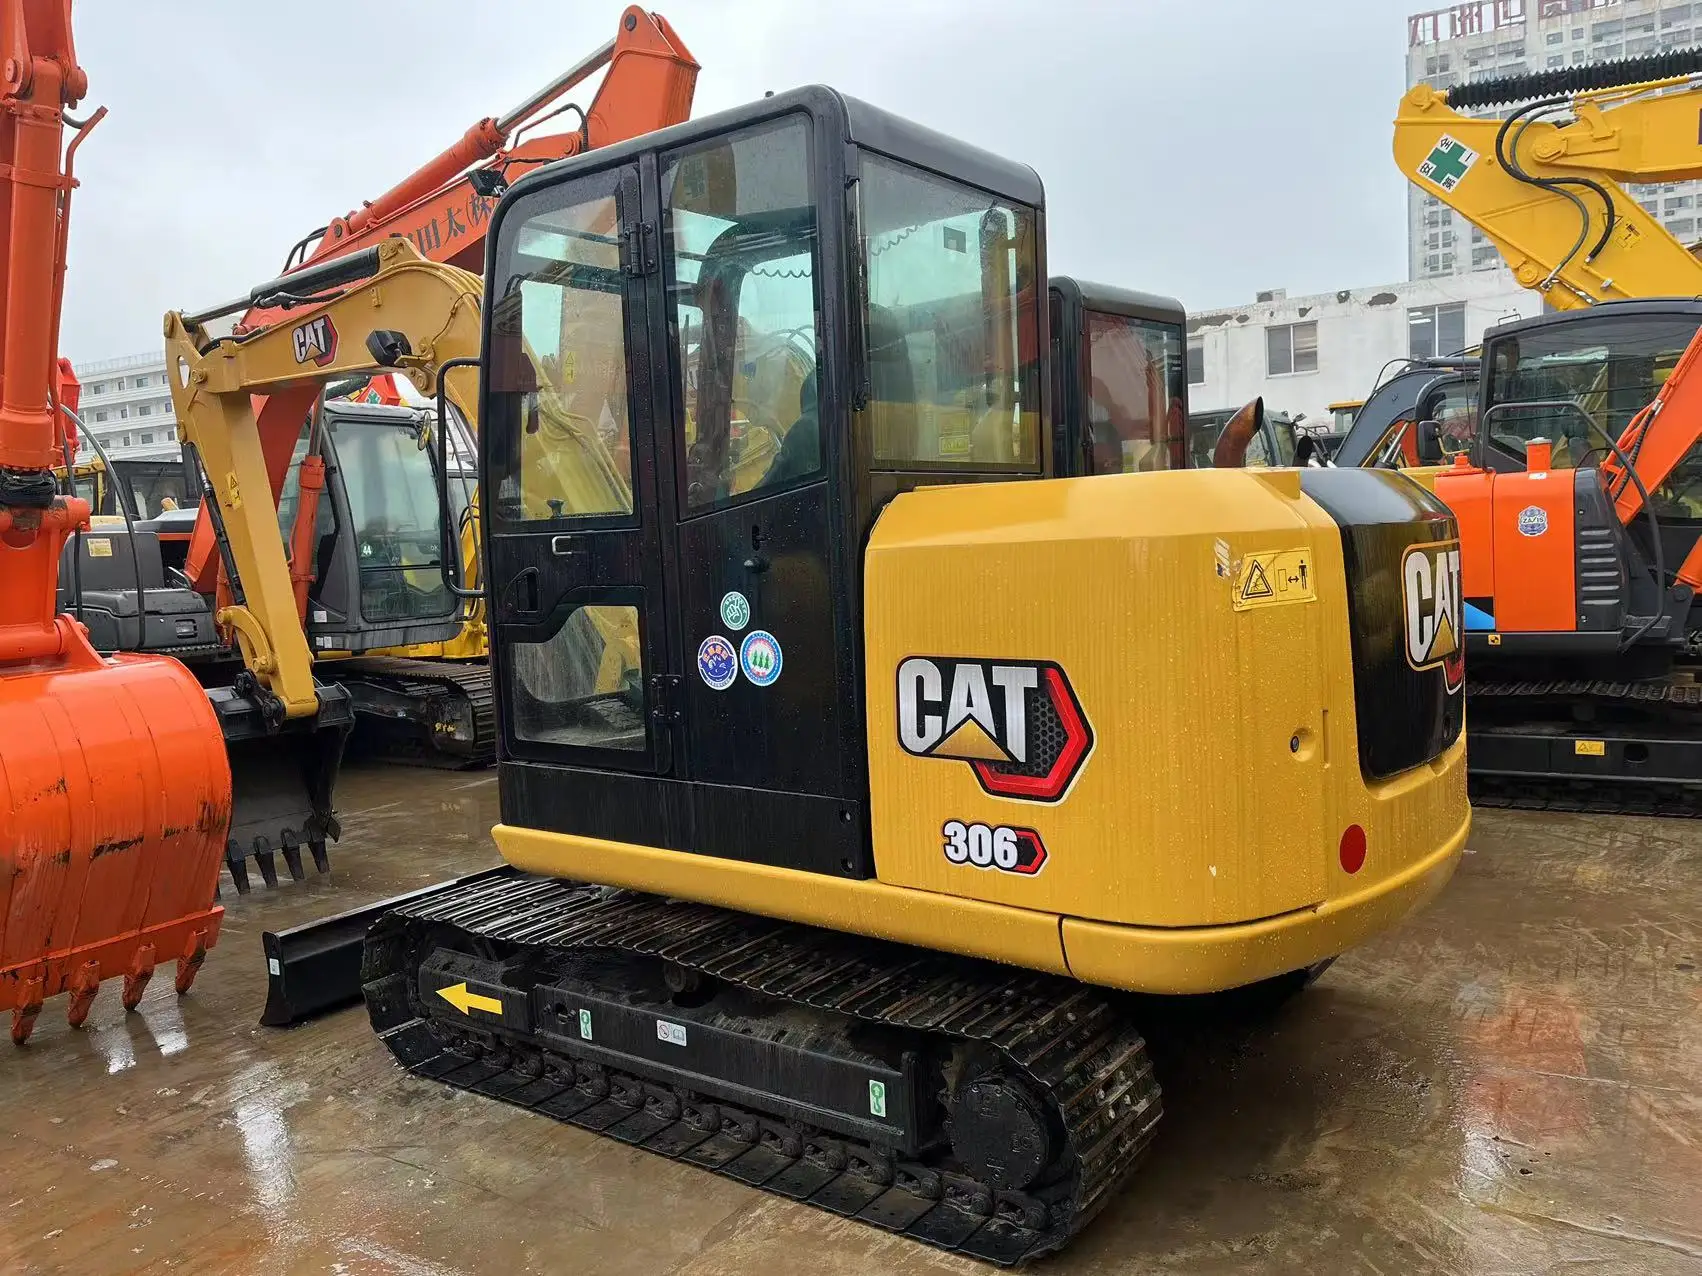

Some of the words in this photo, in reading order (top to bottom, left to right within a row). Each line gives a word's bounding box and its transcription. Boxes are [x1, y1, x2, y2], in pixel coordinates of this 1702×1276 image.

[292, 317, 326, 363] CAT
[1405, 550, 1459, 663] CAT
[898, 658, 1038, 763] CAT
[943, 821, 1019, 869] 306
